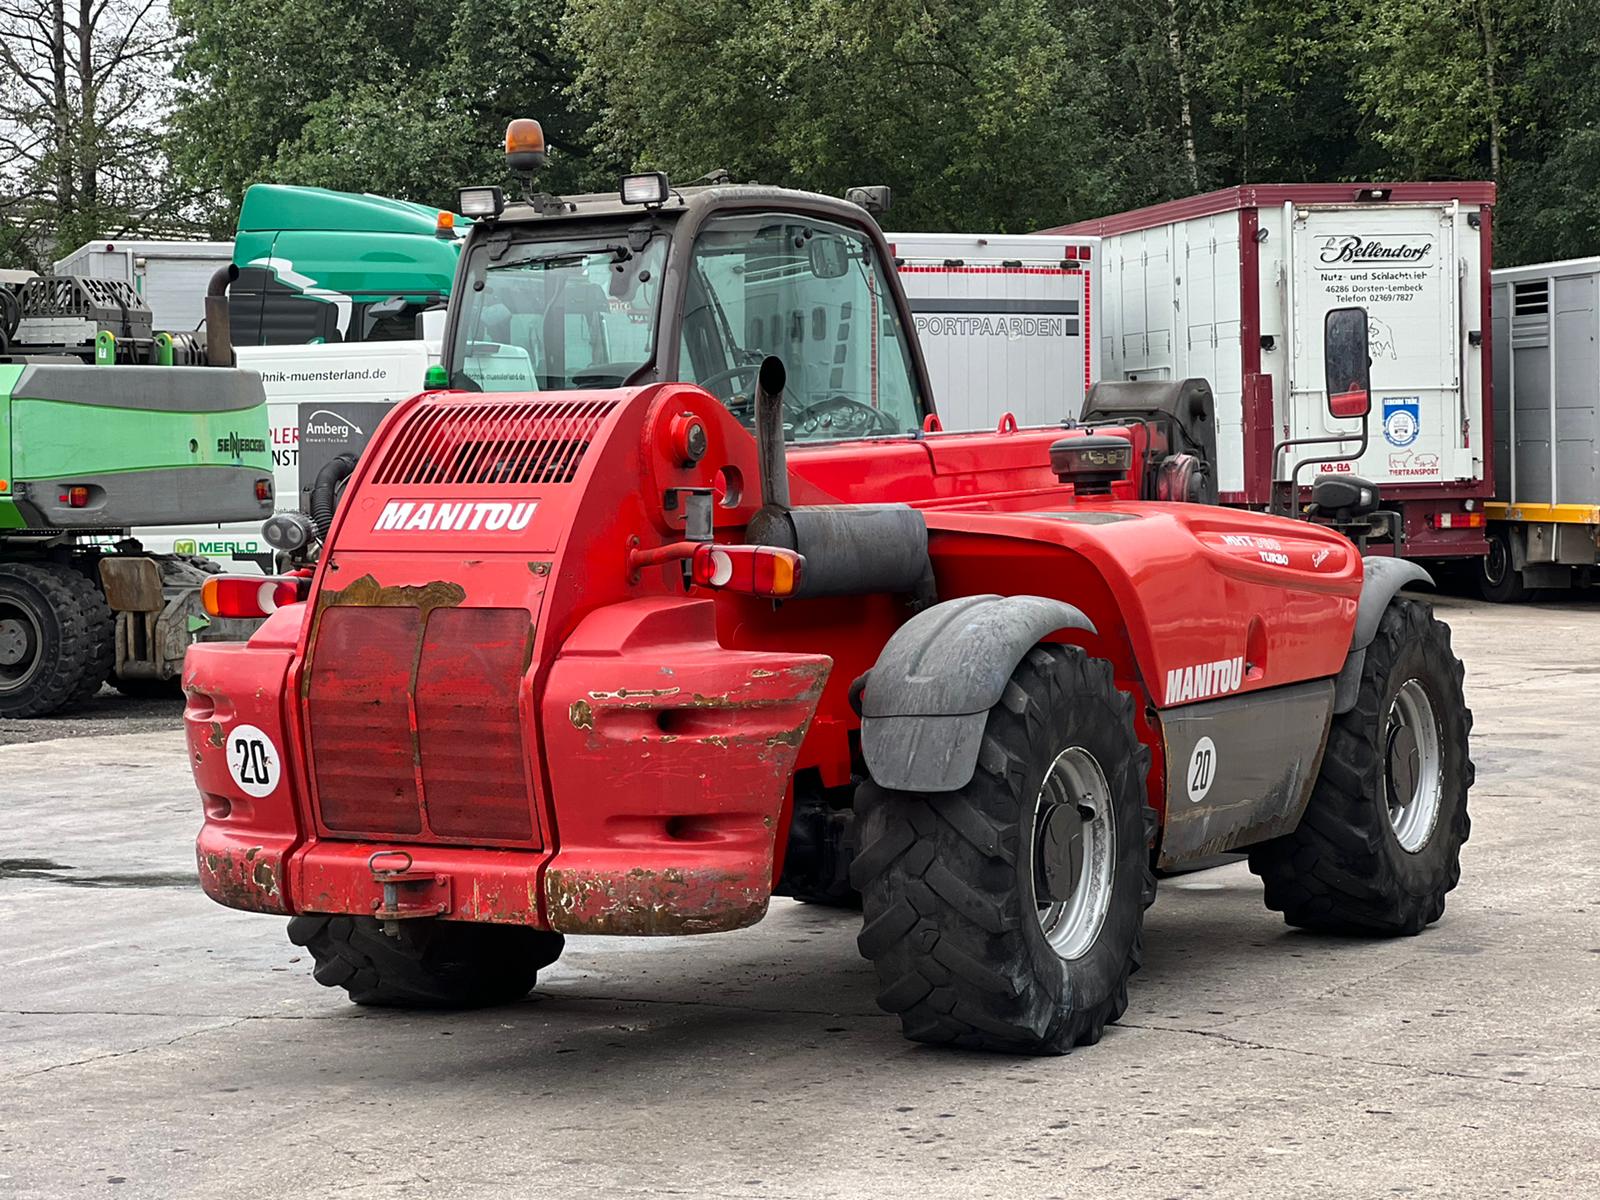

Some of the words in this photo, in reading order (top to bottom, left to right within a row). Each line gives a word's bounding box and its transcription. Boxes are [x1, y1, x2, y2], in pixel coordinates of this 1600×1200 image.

[1320, 236, 1432, 263] Bellendorf
[1350, 272, 1368, 281] und
[1325, 285, 1349, 293] 46286
[1352, 284, 1423, 293] Dorsten-Lembeck
[1336, 295, 1367, 303] Telefon
[1369, 294, 1414, 302] 02369/7827
[915, 317, 1062, 336] PORTPAARDEN
[269, 427, 299, 444] LER
[306, 422, 349, 437] Amberg
[1389, 468, 1439, 476] TIERTRANSPORT
[373, 502, 538, 531] MANITOU
[199, 541, 258, 553] MERLO
[1220, 535, 1254, 547] MHT
[1259, 551, 1289, 566] TURBO
[1165, 656, 1243, 705] MANITOU
[235, 738, 270, 785] 20
[1192, 750, 1210, 791] 20
